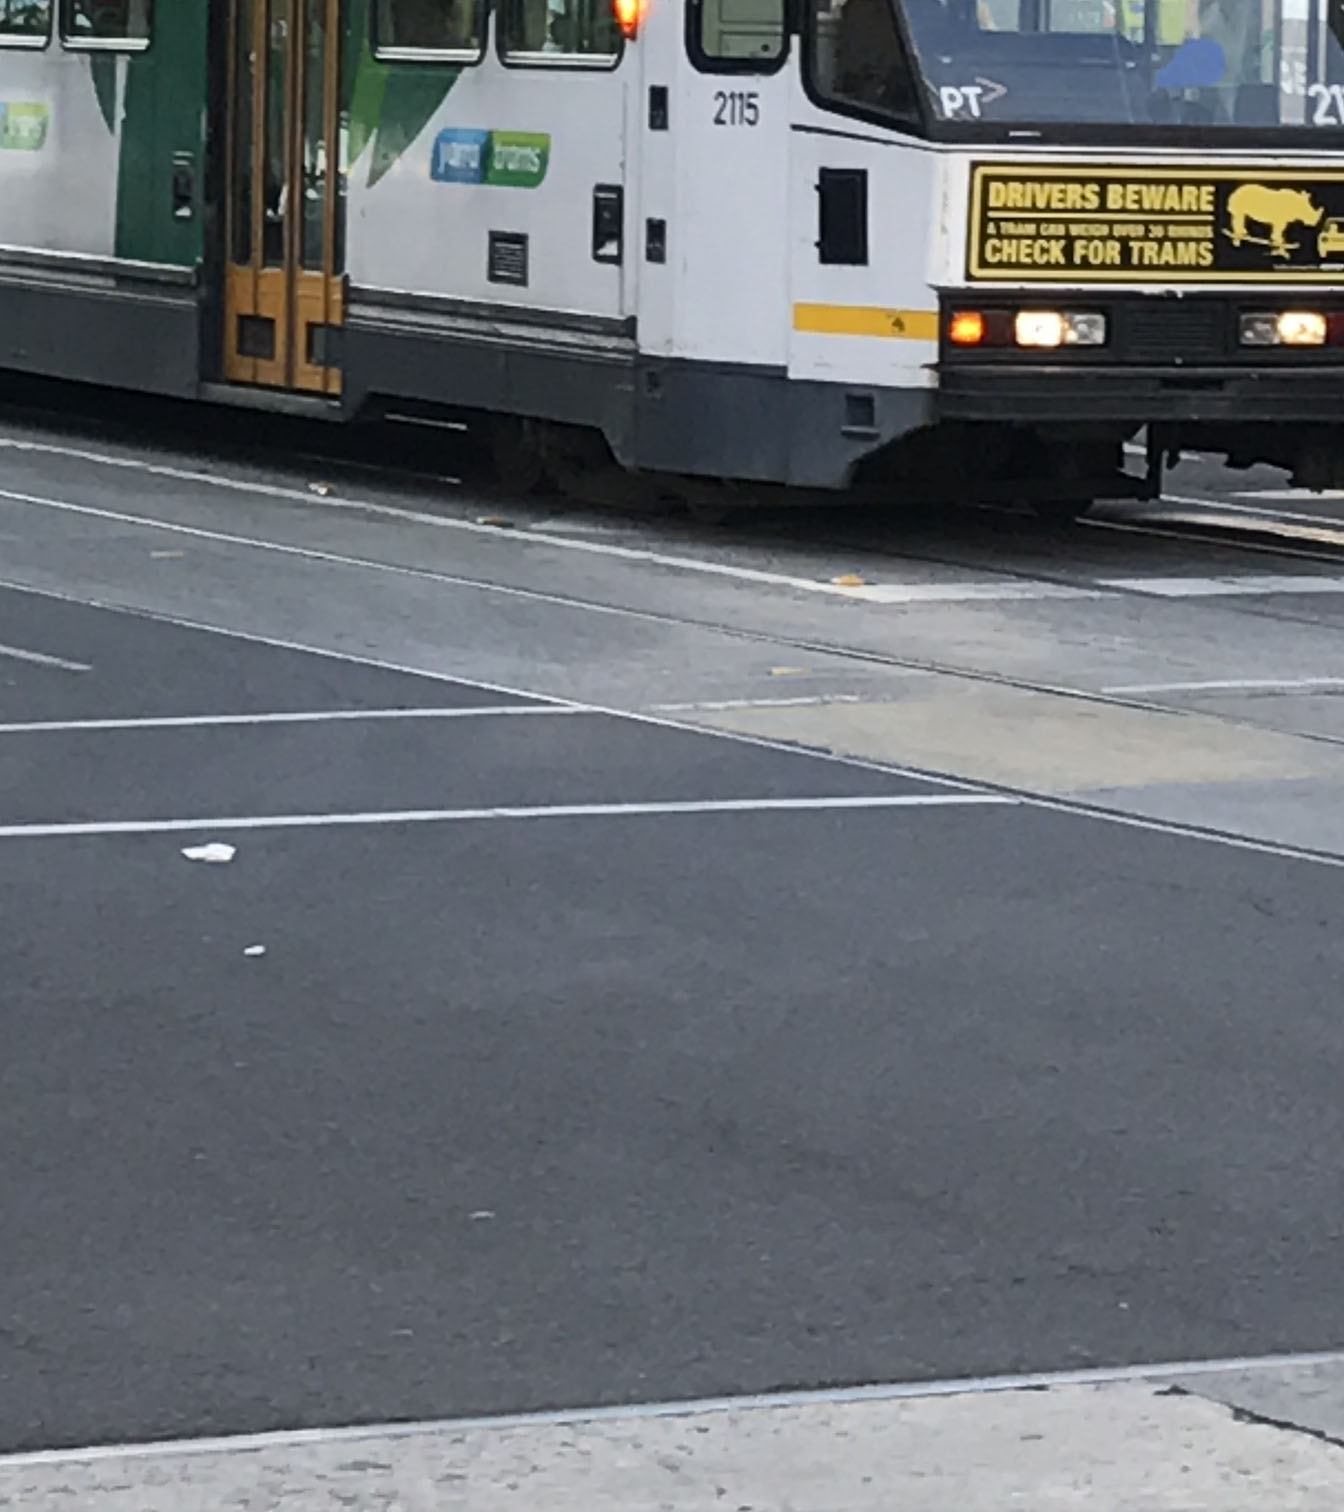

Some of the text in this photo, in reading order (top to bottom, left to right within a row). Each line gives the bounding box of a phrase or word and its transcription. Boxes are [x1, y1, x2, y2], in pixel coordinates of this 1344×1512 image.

[714, 91, 760, 126] 2115
[988, 181, 1216, 211] DRIVERS BEWARE
[984, 239, 1214, 266] CHECK FOR TRAMS
